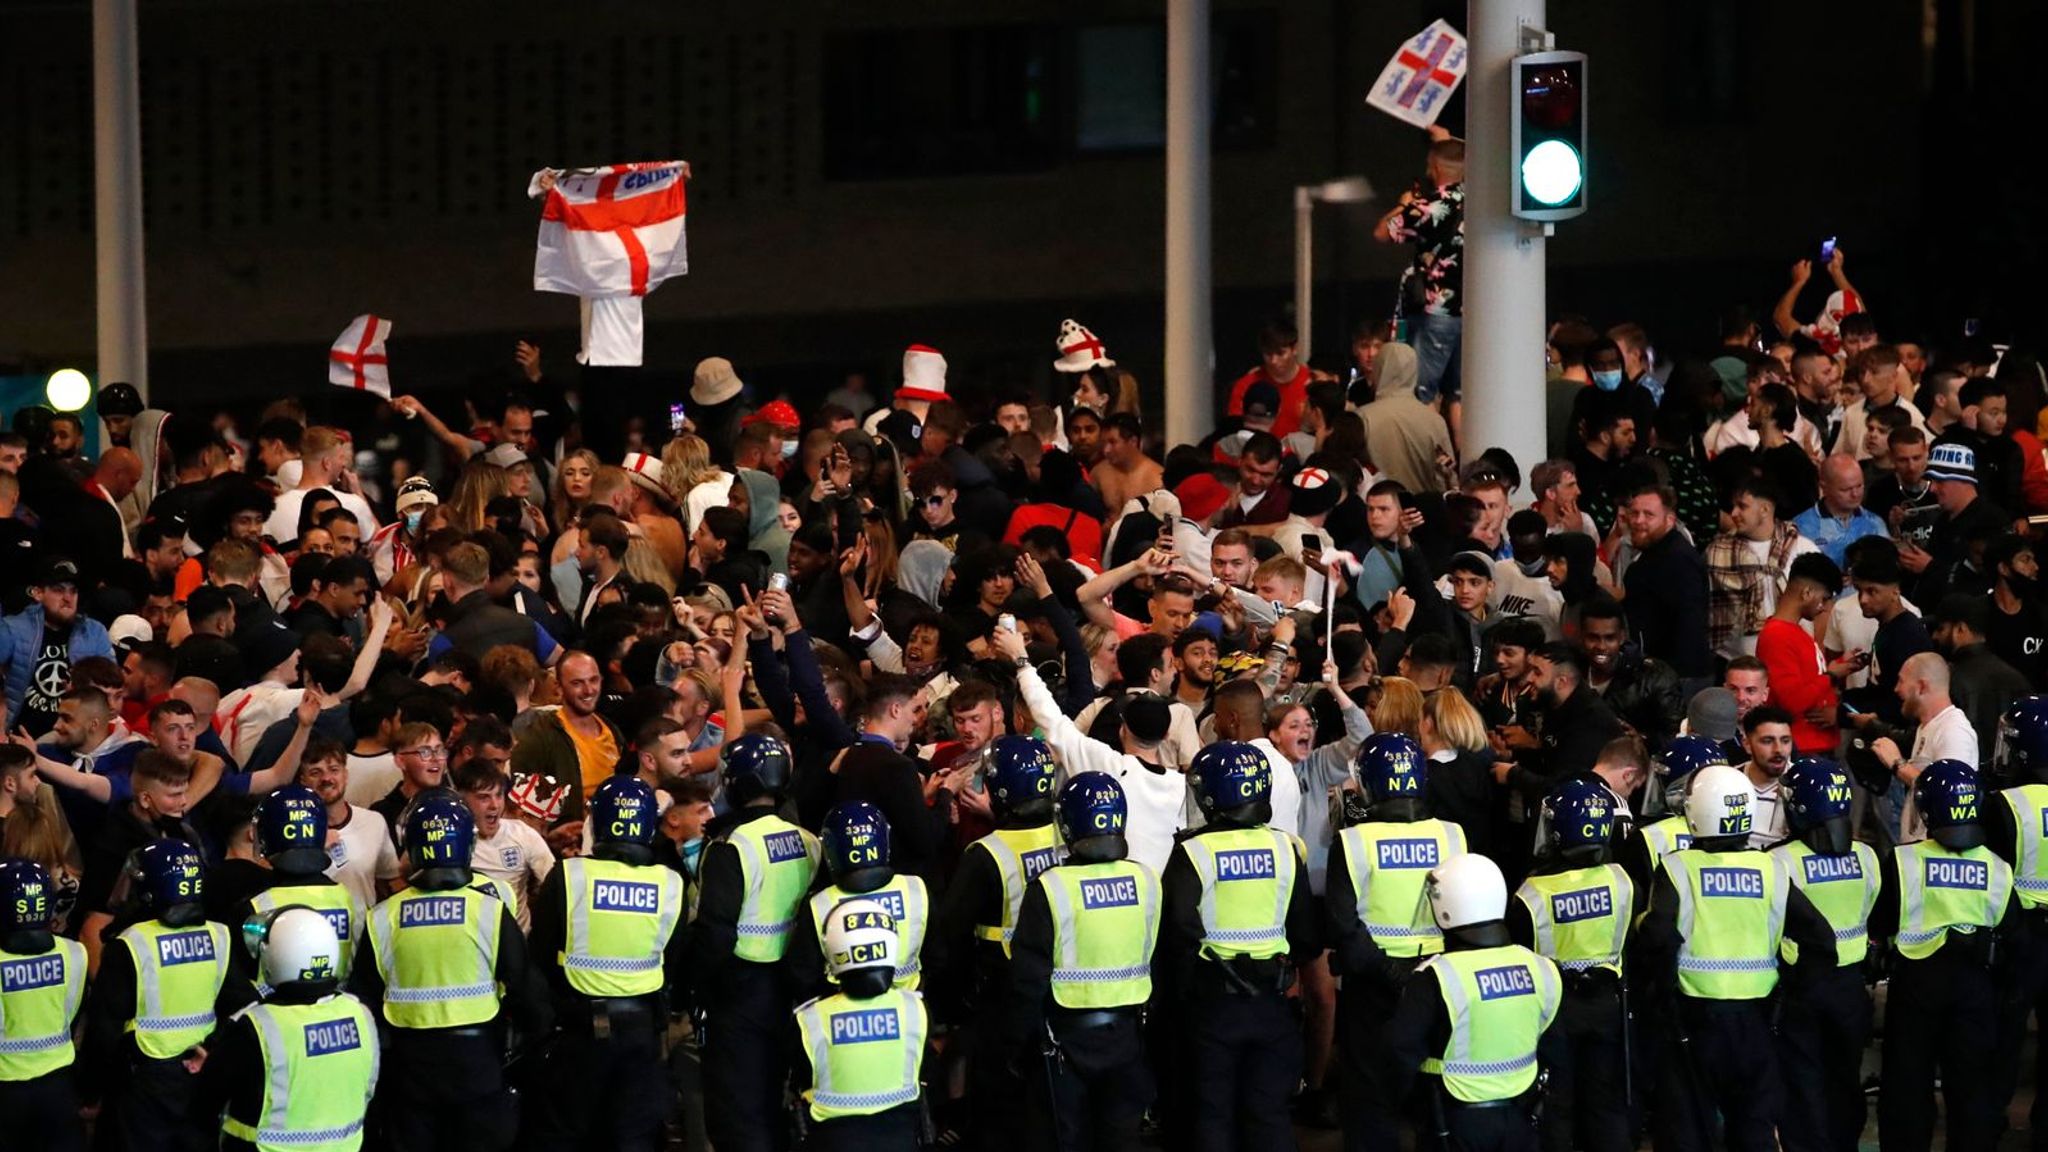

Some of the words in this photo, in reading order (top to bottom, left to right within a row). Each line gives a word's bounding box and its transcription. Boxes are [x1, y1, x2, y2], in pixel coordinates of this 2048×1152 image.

[1499, 594, 1535, 617] NIKE
[1243, 765, 1258, 778] MP
[1393, 763, 1412, 774] MP
[1240, 779, 1262, 797] CN
[1388, 777, 1417, 791] NA
[1827, 787, 1852, 802] WA
[1958, 795, 1975, 805] MP
[289, 810, 308, 821] MP
[618, 809, 637, 819] MP
[1589, 807, 1606, 818] MP
[1729, 807, 1747, 816] MP
[1950, 806, 1977, 820] WA
[611, 822, 641, 836] CN
[1094, 814, 1122, 829] CN
[1723, 818, 1751, 832] YE
[283, 823, 314, 840] CN
[427, 831, 446, 842] MP
[1582, 823, 1610, 838] CN
[766, 835, 804, 858] POLICE
[852, 835, 870, 847] MP
[422, 844, 452, 860] NI
[848, 847, 879, 864] CN
[1380, 844, 1436, 864] POLICE
[183, 867, 199, 878] MP
[1218, 853, 1273, 877] POLICE
[1805, 856, 1861, 879] POLICE
[1928, 863, 1986, 885] POLICE
[25, 884, 42, 895] MP
[179, 879, 202, 896] SE
[1703, 873, 1761, 893] POLICE
[596, 884, 656, 908] POLICE
[1084, 881, 1136, 905] POLICE
[16, 897, 45, 914] SE
[403, 901, 462, 922] POLICE
[1554, 891, 1610, 918] POLICE
[160, 935, 212, 961] POLICE
[853, 943, 885, 962] CN
[311, 957, 329, 967] MP
[3, 960, 62, 986] POLICE
[1479, 969, 1533, 995] POLICE
[833, 1013, 897, 1040] POLICE
[307, 1022, 358, 1051] POLICE
